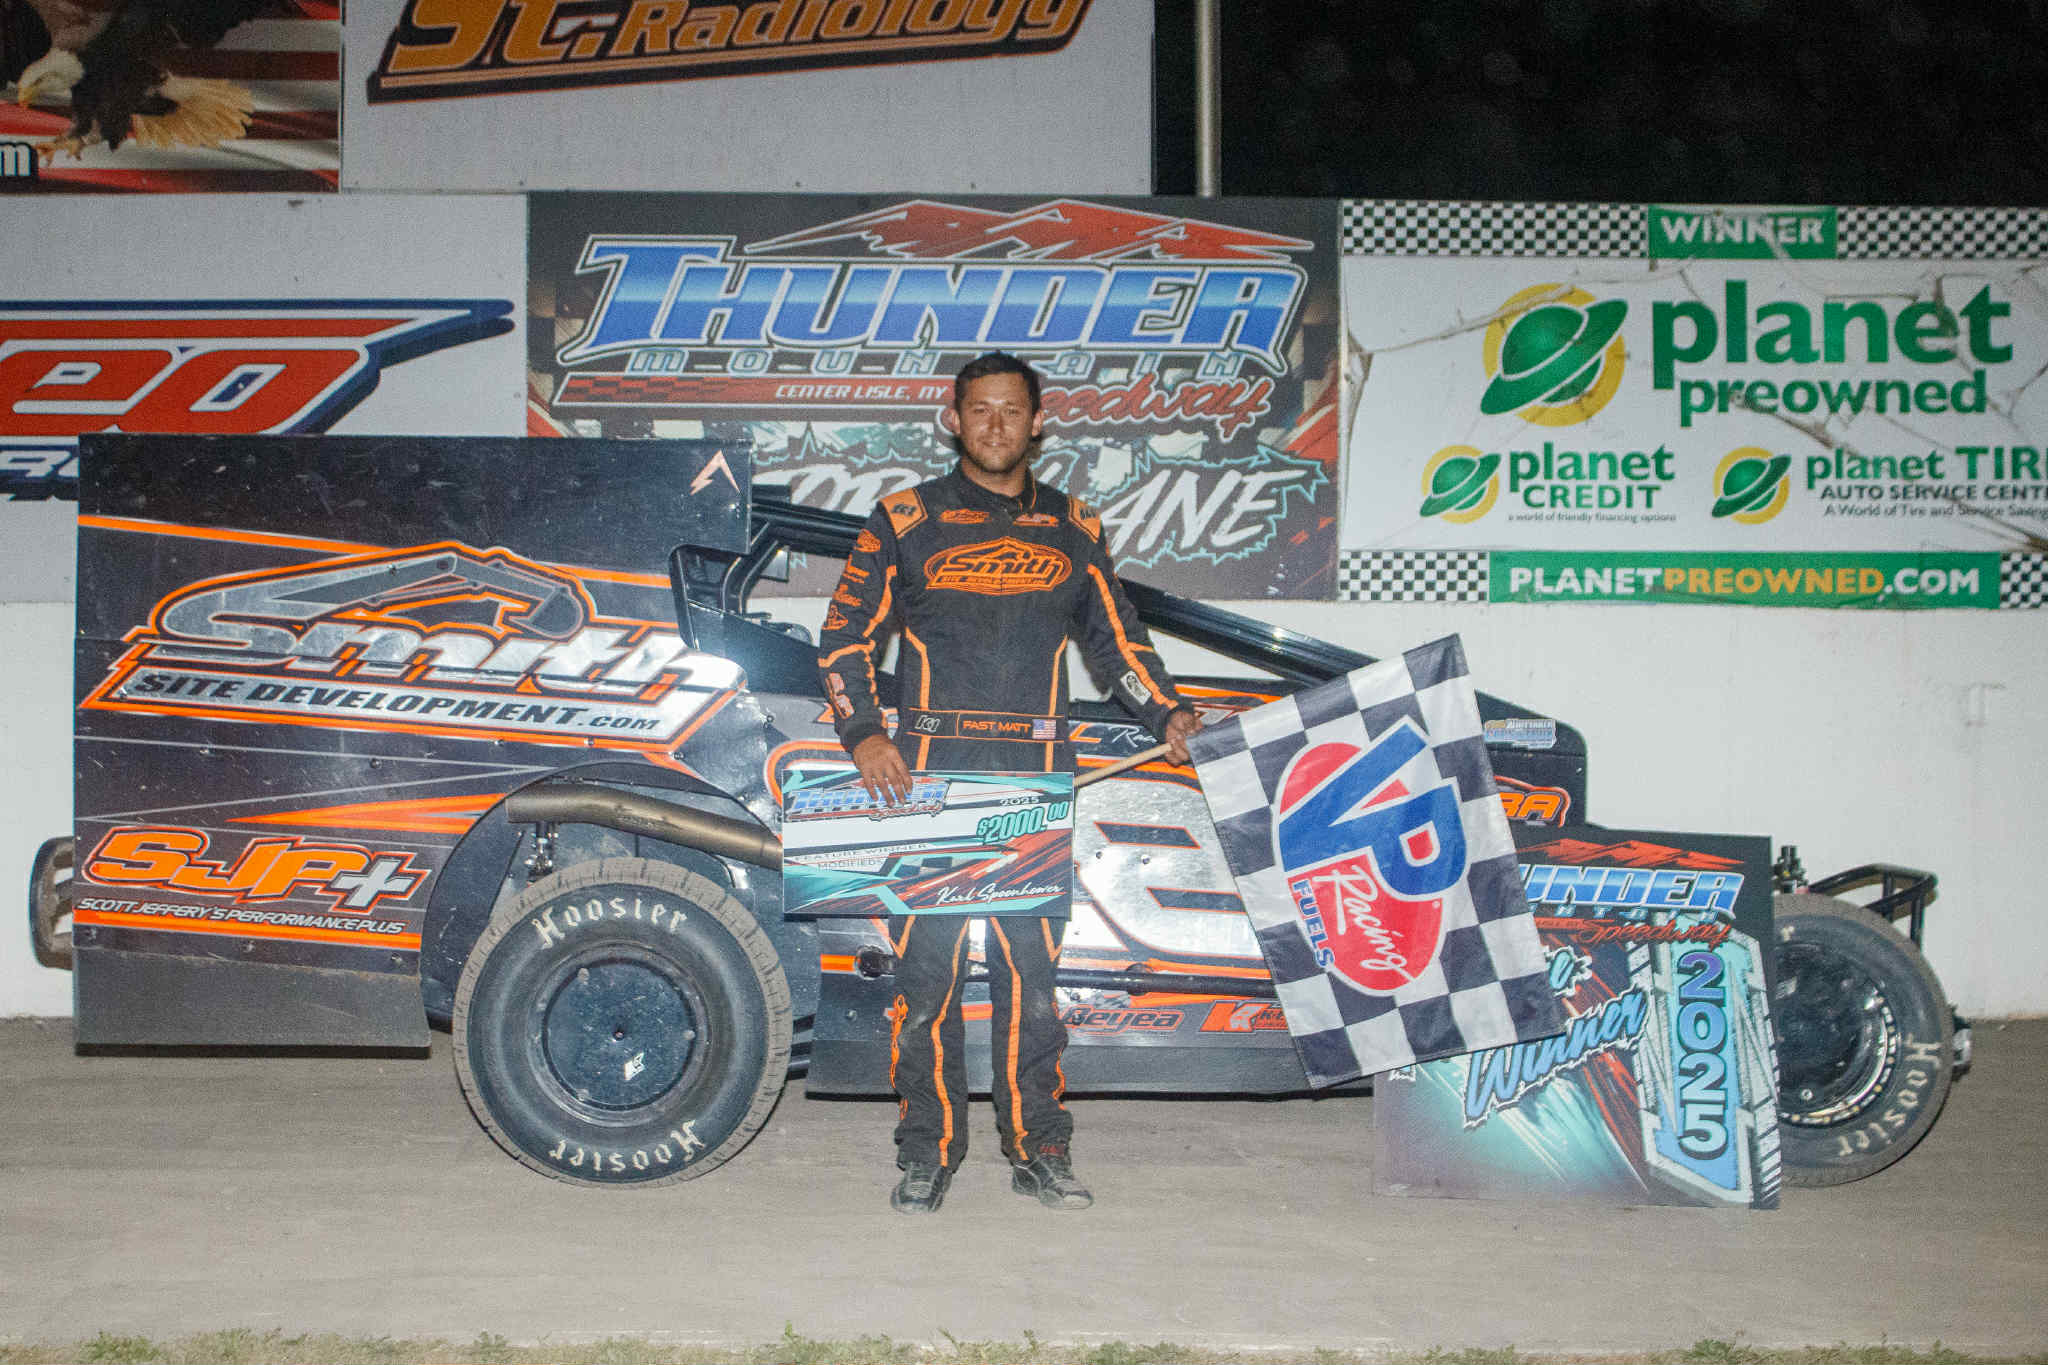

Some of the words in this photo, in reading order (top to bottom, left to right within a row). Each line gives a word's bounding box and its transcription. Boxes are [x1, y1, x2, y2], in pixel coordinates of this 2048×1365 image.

[1660, 215, 1825, 243] WINNER
[558, 236, 1306, 376] THUNDER
[1651, 279, 2014, 390] planet
[775, 384, 851, 400] CENTER
[918, 385, 948, 400] NY
[1680, 370, 1988, 428] preowned
[1509, 441, 1676, 493] planet
[1806, 448, 1946, 490] planet
[1955, 446, 2048, 480] TIR
[1101, 468, 1306, 556] ANE
[1523, 484, 1662, 509] CREDIT
[1820, 484, 1885, 500] AUTO
[1890, 485, 1978, 501] SERVICE
[1984, 485, 2048, 500] CENT
[1838, 503, 1881, 516] World
[1884, 503, 1897, 516] of
[1930, 503, 1953, 516] and
[941, 547, 1064, 579] Smith
[1510, 566, 1980, 595] PLANETPREOWNED.COM
[146, 575, 746, 696] Smith
[133, 672, 240, 699] SITE
[962, 719, 998, 731] FAST
[998, 721, 1032, 734] MATT
[1000, 796, 1040, 807] 2025
[864, 843, 928, 856] WINNER
[1521, 863, 1745, 918] UNDER
[78, 898, 138, 914] SCOTT
[134, 901, 224, 921] JEFFERY'S
[222, 908, 353, 930] PERFORMANCE
[351, 918, 405, 934] PLUS
[532, 897, 688, 950] Hoosier
[1291, 879, 1336, 970] FUELS
[1313, 864, 1415, 986] Racing
[1579, 920, 1732, 951] Speedway
[1677, 950, 1729, 1161] 2025
[1836, 1033, 1942, 1157] Hoosier
[549, 1119, 705, 1172] Hoosier
